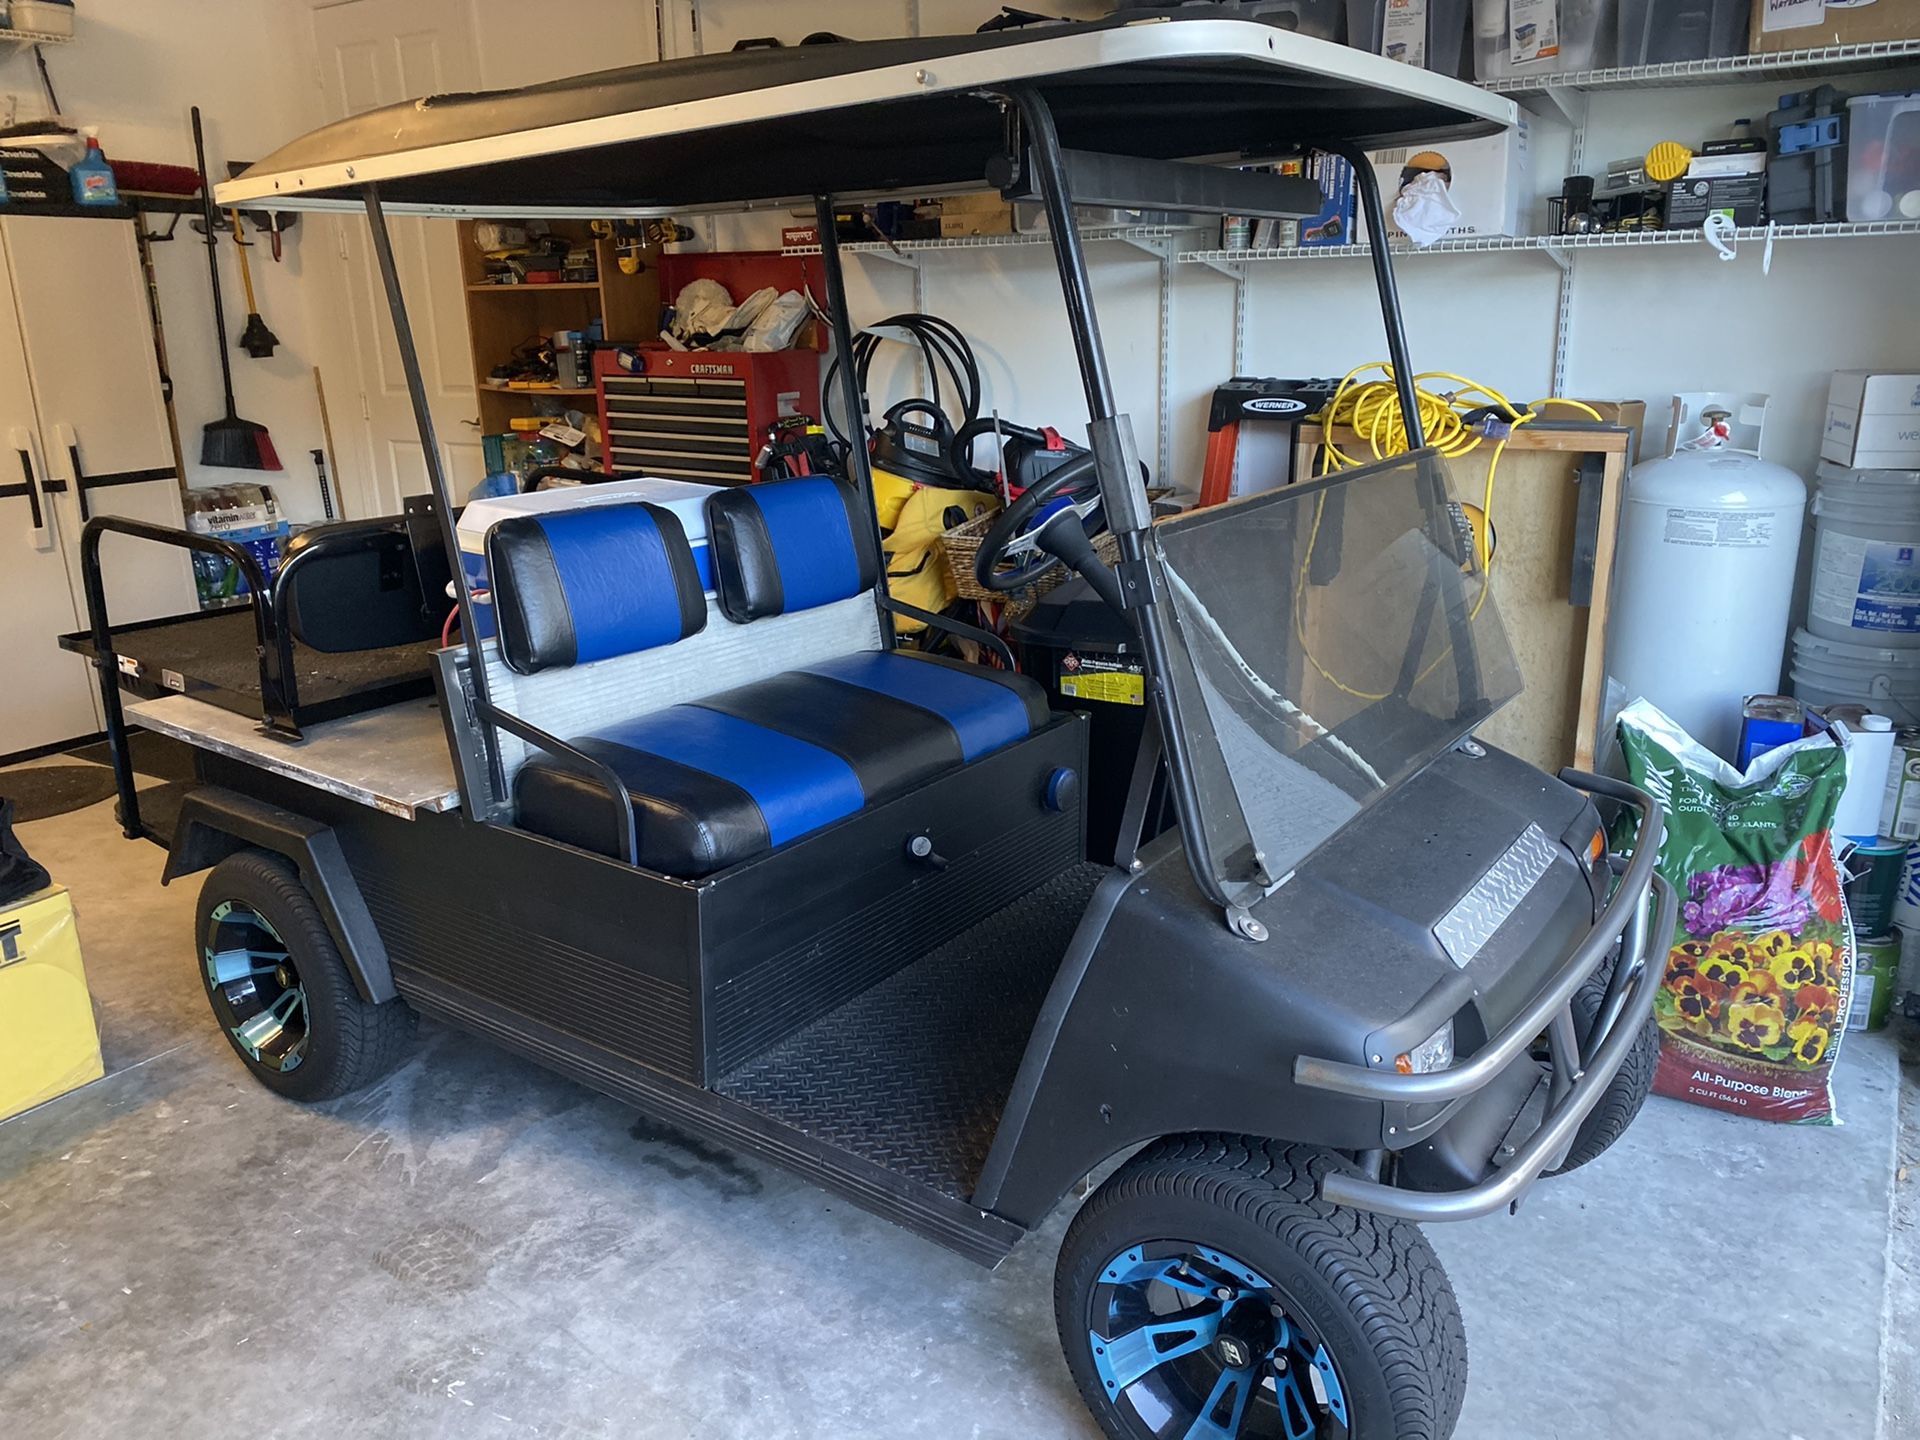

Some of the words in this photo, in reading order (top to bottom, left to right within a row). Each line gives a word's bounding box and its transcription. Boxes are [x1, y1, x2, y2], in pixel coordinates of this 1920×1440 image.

[690, 364, 733, 374] CRAFTSMAN
[1254, 401, 1295, 409] WERNER
[1836, 930, 1851, 1024] PROFESSIONAL
[1691, 1069, 1769, 1096] All-Purpose
[1696, 1088, 1708, 1096] CU
[1708, 1090, 1717, 1098] FT
